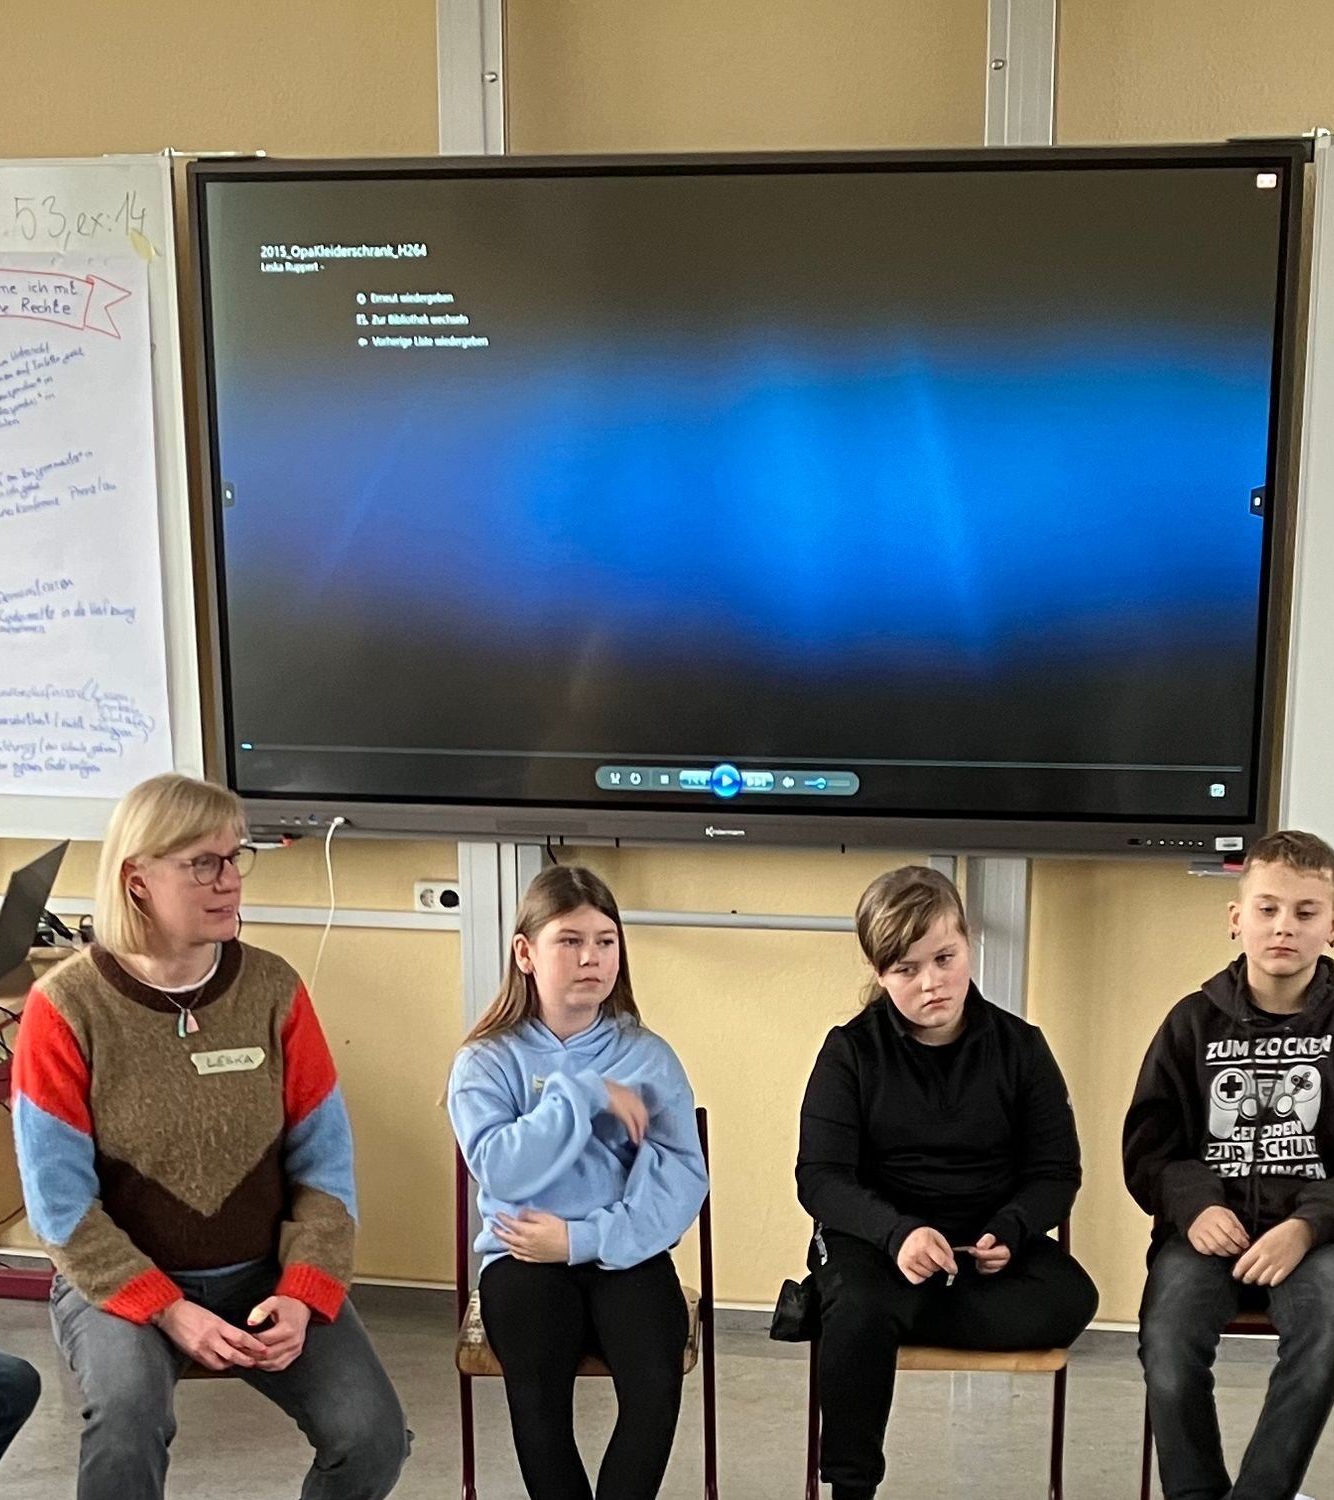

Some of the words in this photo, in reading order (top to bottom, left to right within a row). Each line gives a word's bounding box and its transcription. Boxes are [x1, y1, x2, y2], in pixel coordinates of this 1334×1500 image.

[27, 279, 50, 294] ich
[53, 279, 78, 296] mit
[20, 297, 72, 316] Rechte
[1205, 1039, 1250, 1061] ZUM
[1254, 1034, 1333, 1057] ZOCKEN
